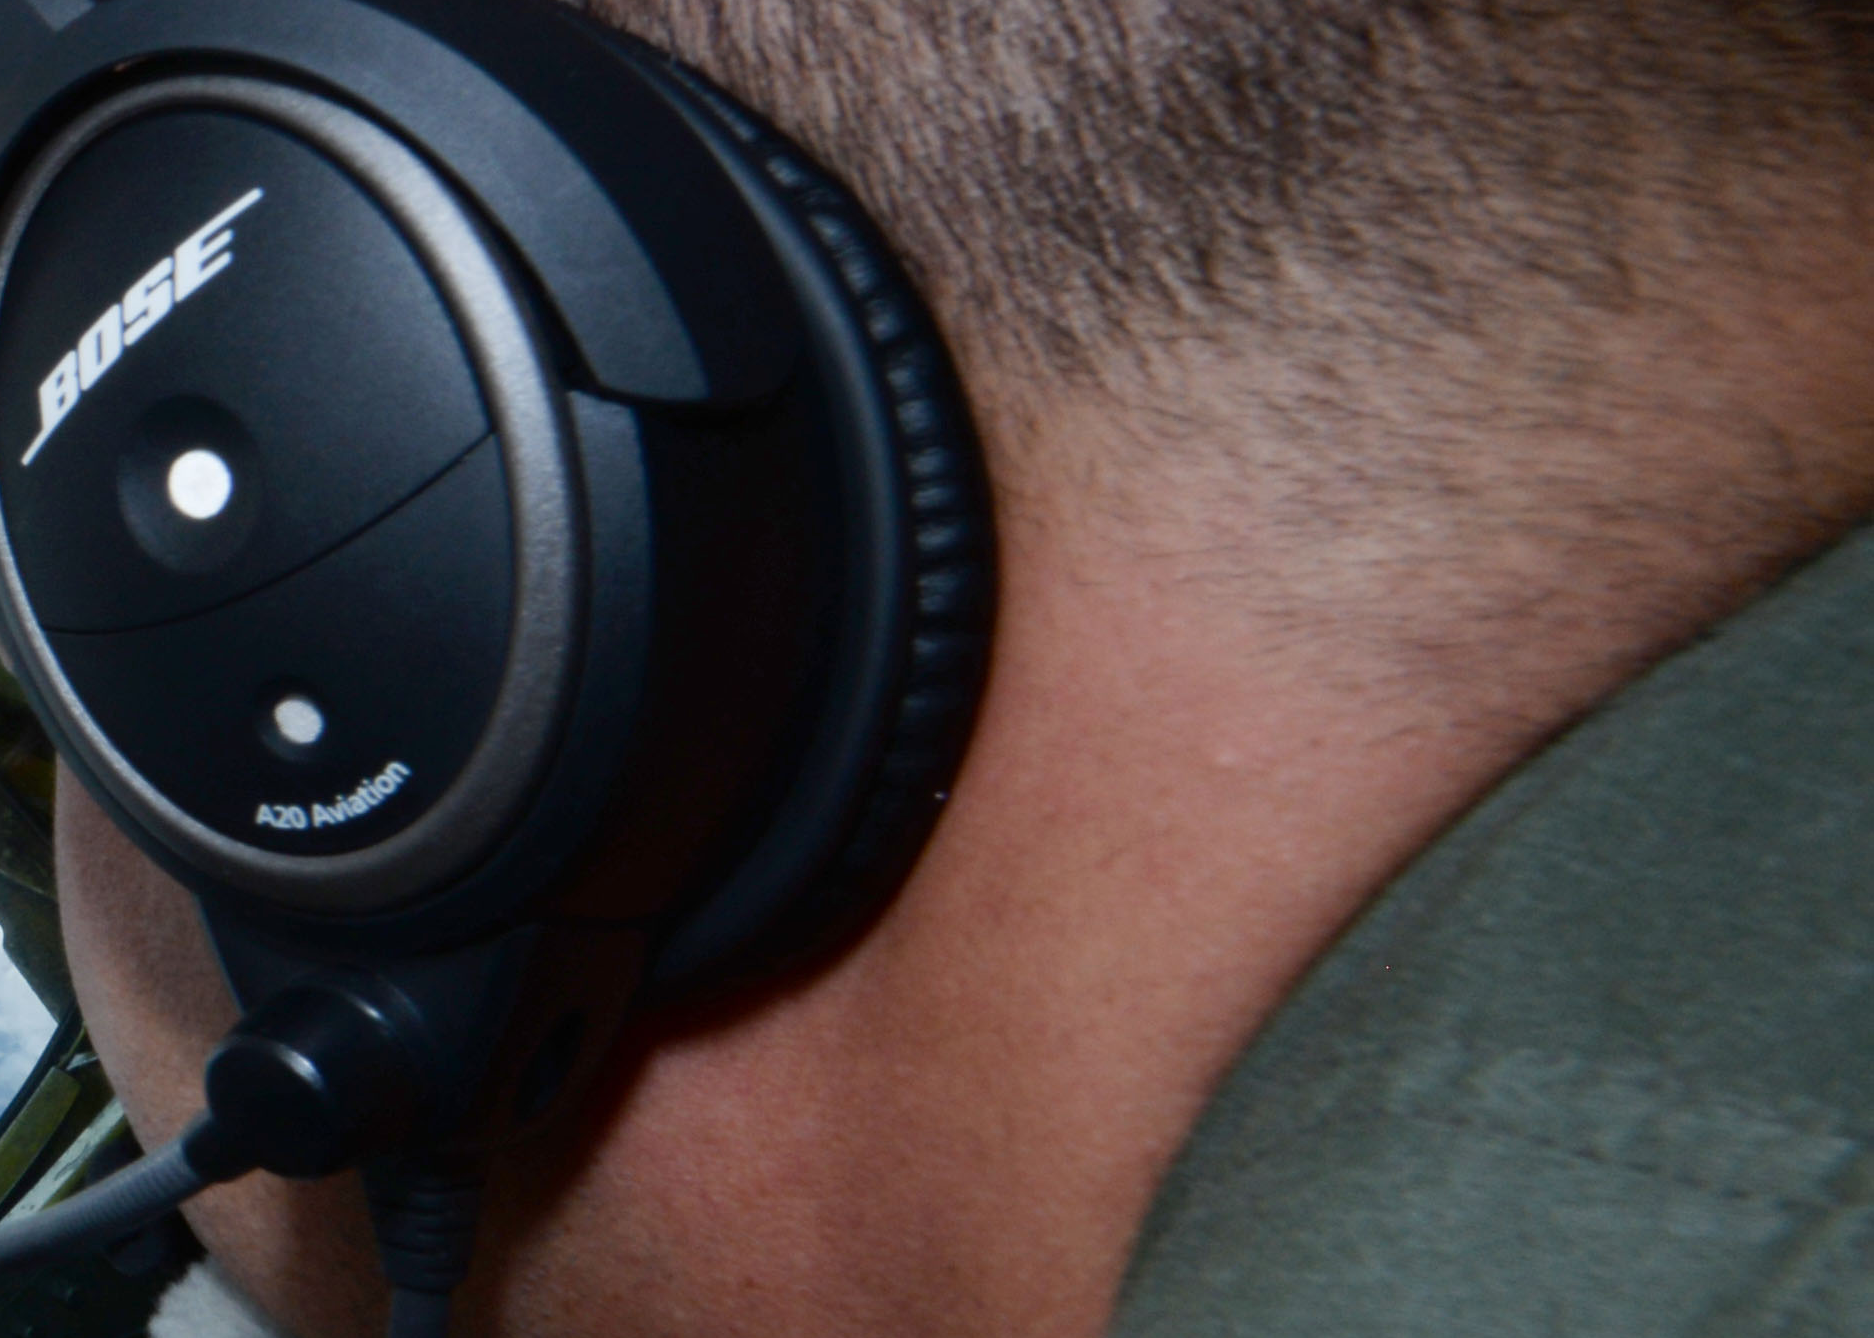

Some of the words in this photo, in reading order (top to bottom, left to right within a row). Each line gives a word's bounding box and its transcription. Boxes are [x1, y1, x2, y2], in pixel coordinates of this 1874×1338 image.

[21, 187, 263, 466] BOSE
[256, 801, 307, 830] A20
[313, 759, 411, 830] Aviation
